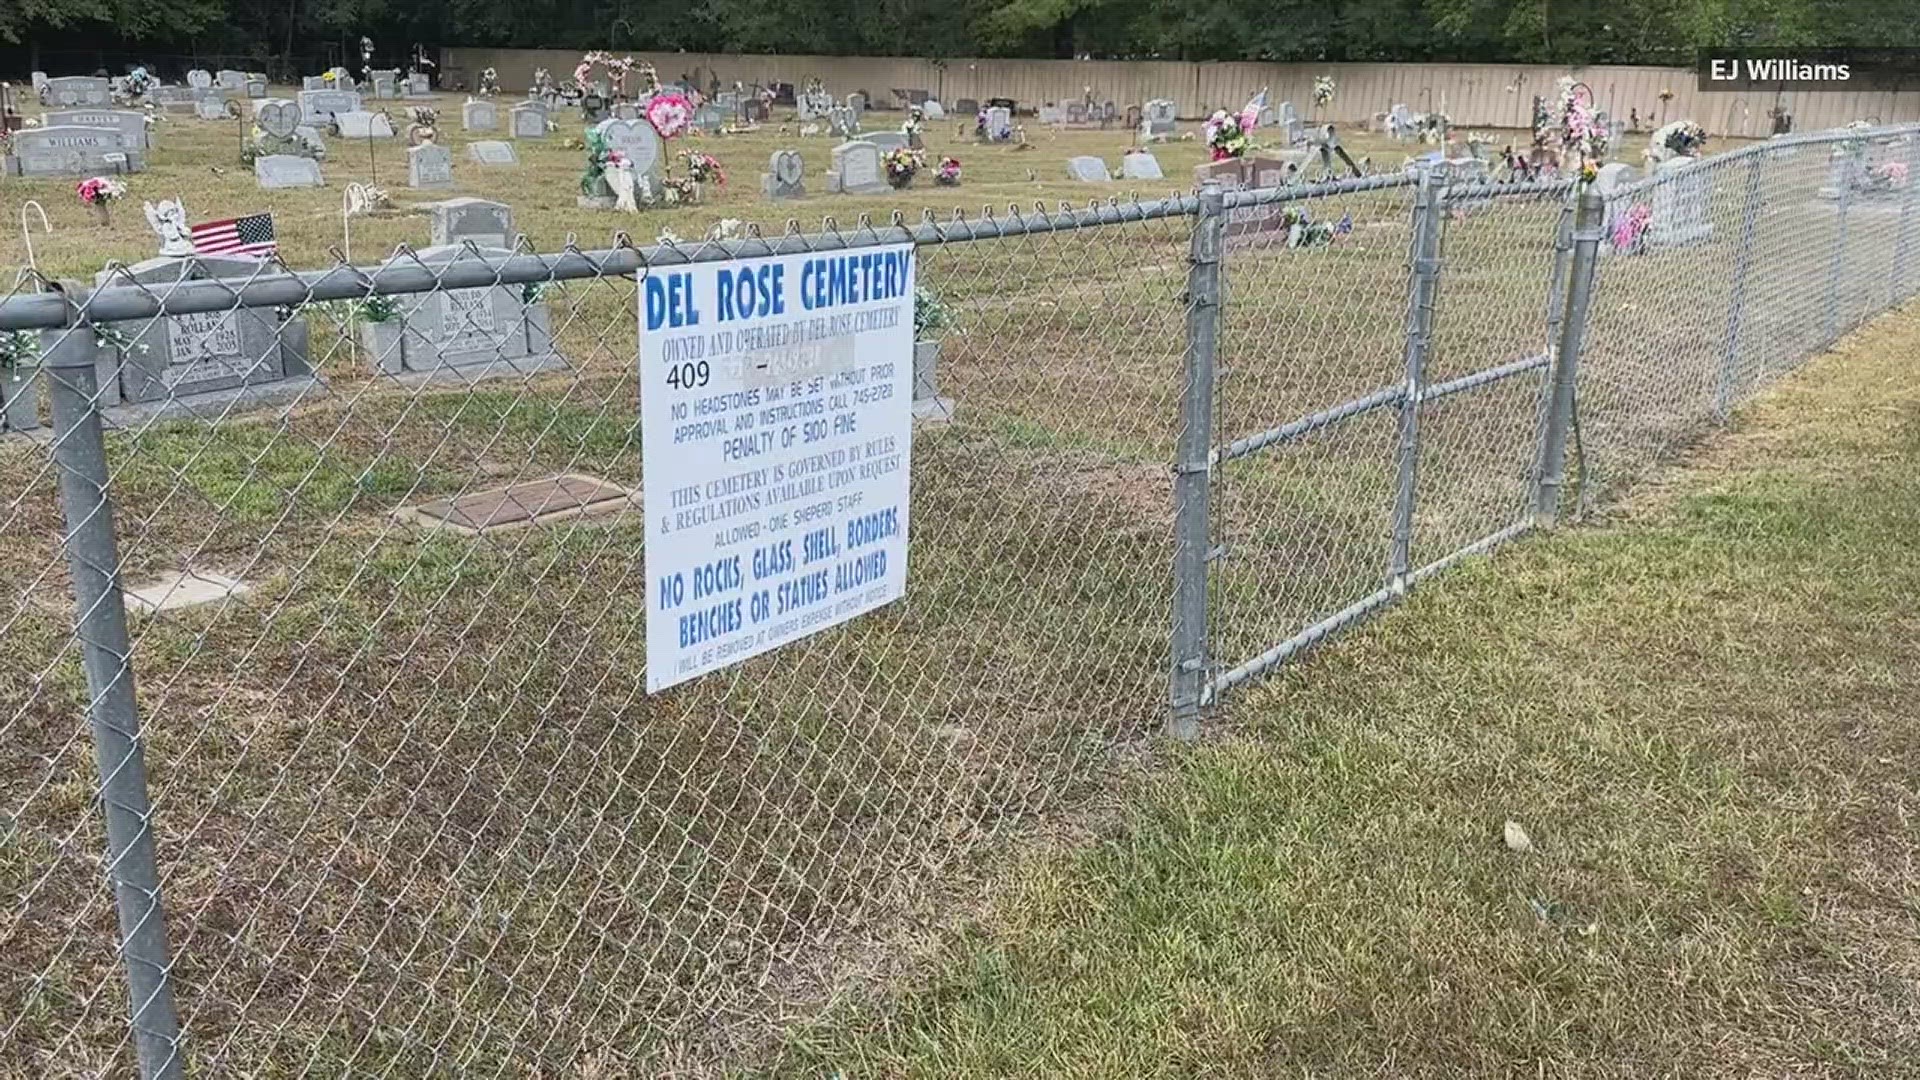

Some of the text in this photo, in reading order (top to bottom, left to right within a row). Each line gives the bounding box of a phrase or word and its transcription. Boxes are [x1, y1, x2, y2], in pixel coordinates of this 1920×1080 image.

[48, 137, 99, 147] WILLIAMS
[646, 250, 910, 331] DEL ROSE CEMETERY
[662, 335, 705, 363] OWNED
[709, 331, 733, 357] AND
[736, 324, 788, 351] OPERATED
[792, 322, 806, 343] BY
[808, 319, 826, 341] DEL
[829, 314, 851, 338] ROSE
[854, 307, 901, 331] CEMETERY
[667, 360, 710, 390] 409
[671, 362, 894, 420] NO HEADSTONES MAY BE SET WITHOUT PRIOR
[674, 418, 728, 444] APPROVAL
[734, 413, 754, 434] AND
[759, 398, 824, 426] INSTRUCTIONS
[829, 393, 848, 411] CALL
[723, 430, 774, 462] PENALTY
[781, 425, 797, 448] OF
[834, 411, 856, 436] FINE
[661, 454, 901, 534] & REGULATIONS AVAILABLE UPON REQUEST
[671, 434, 895, 508] THIS CEMETERY IS GOVERNED BY RULES
[714, 522, 760, 549] ALLOWED
[769, 514, 789, 533] ONE
[793, 502, 833, 527] SHEPERD
[837, 491, 864, 512] STAFF
[660, 506, 900, 610] NO ROCKS, GLASS, SHELL, BORDERS,
[679, 549, 886, 649] BENCHES OR STATUES ALLOWED
[702, 651, 714, 667] BE
[755, 630, 767, 646] AT
